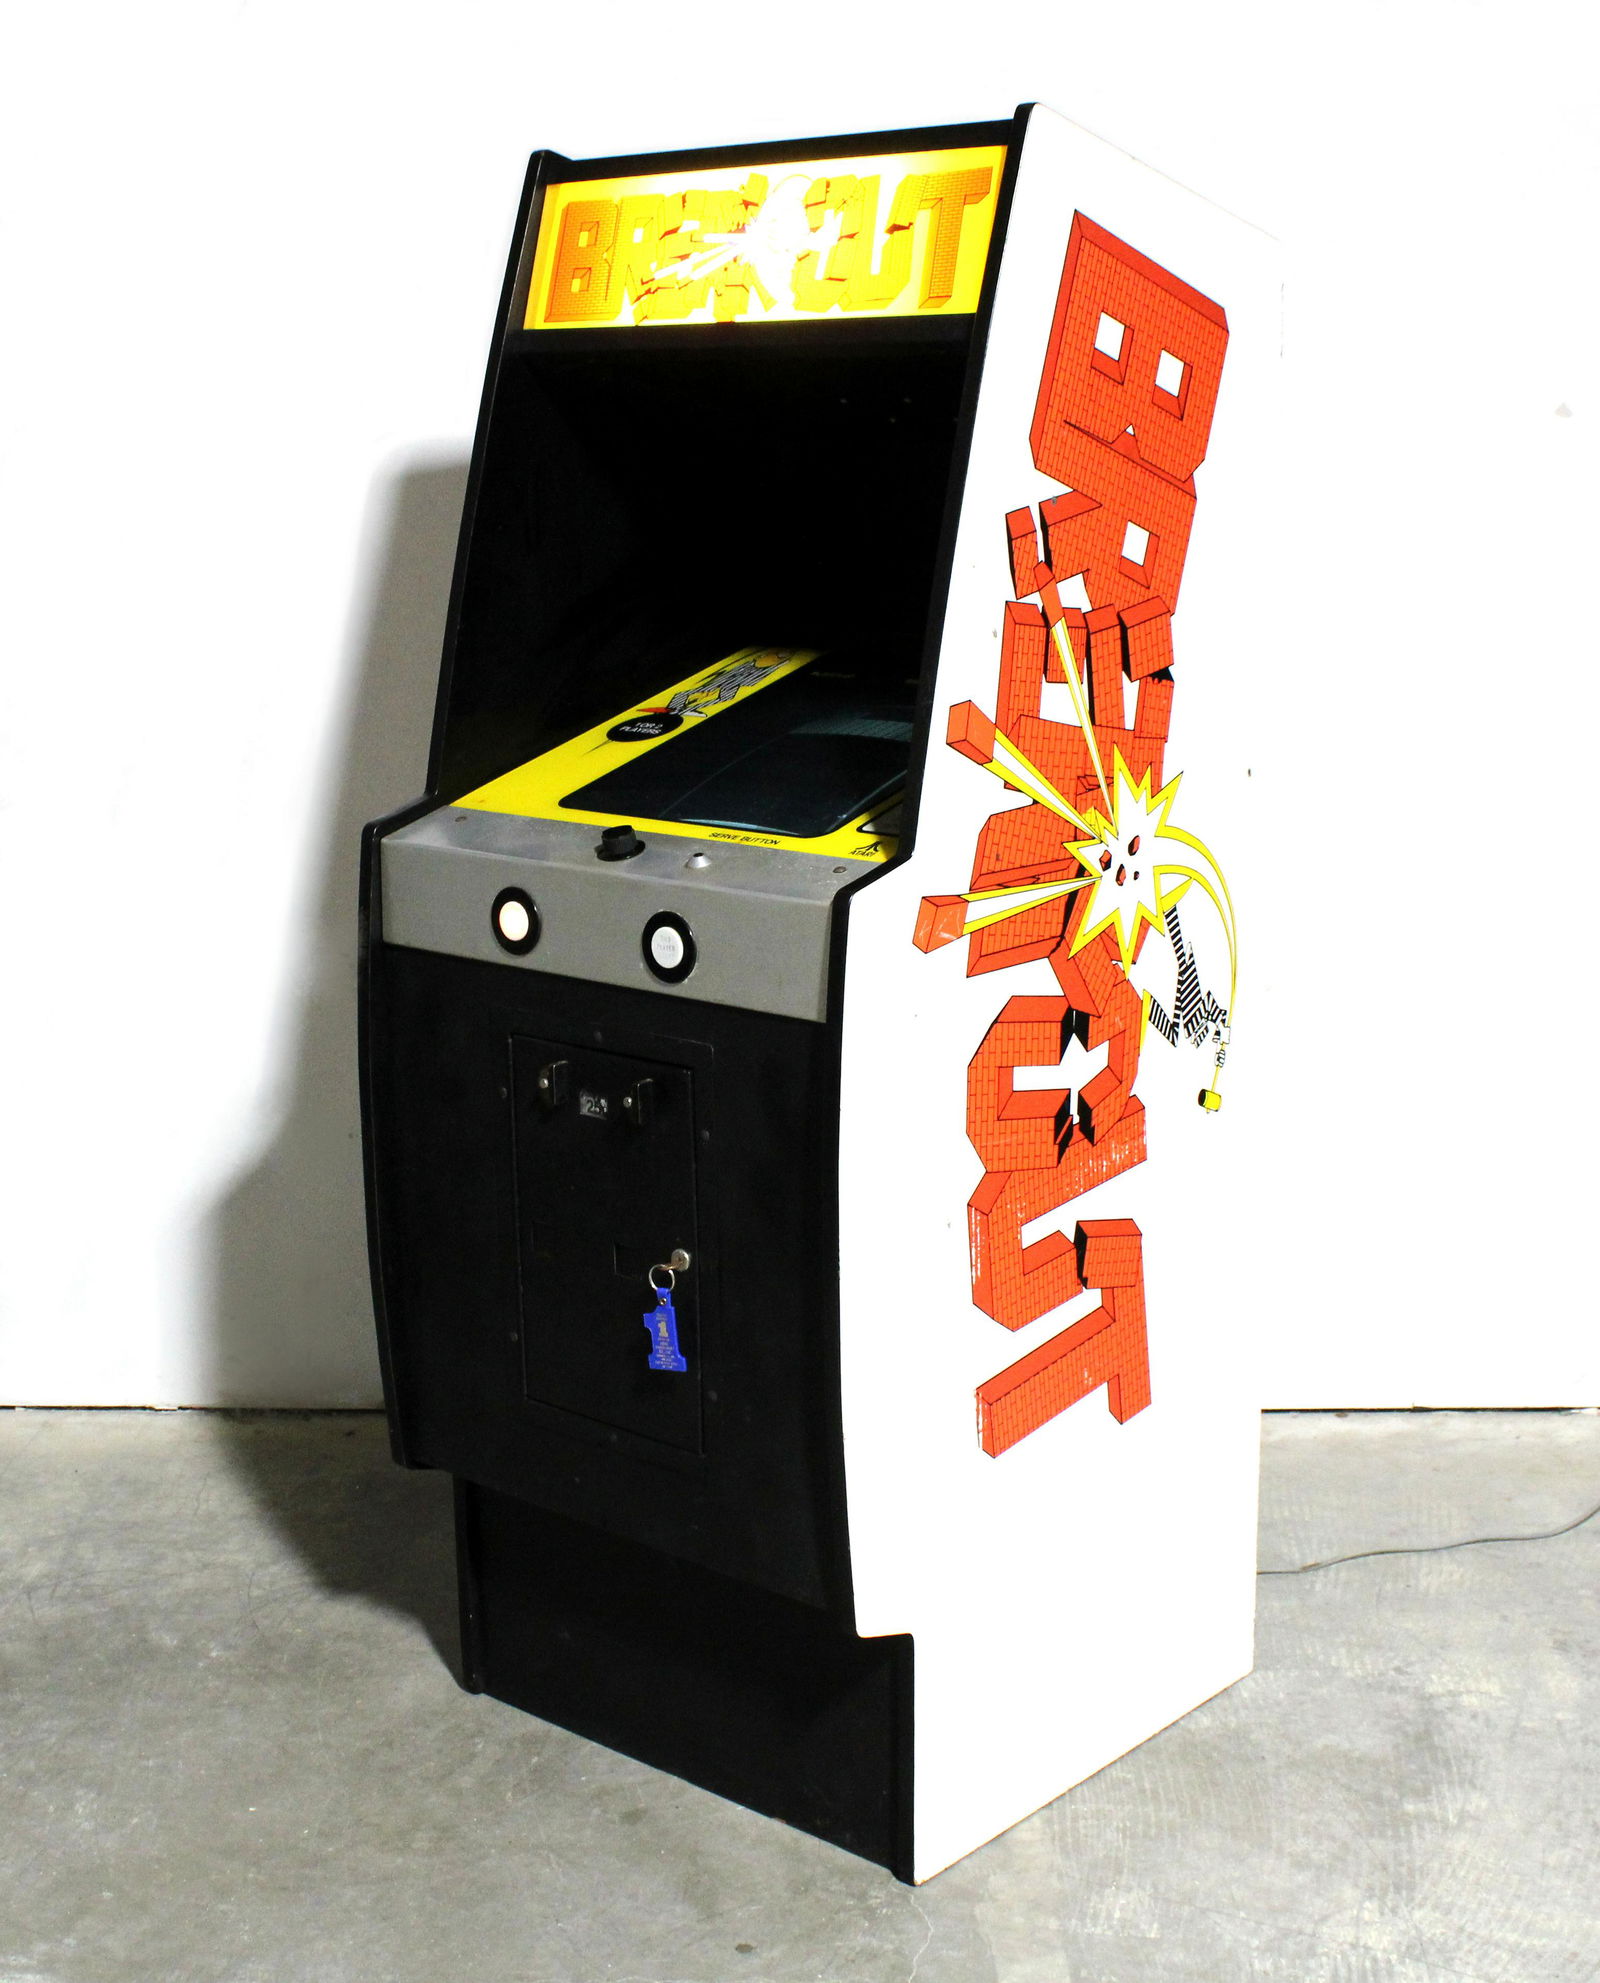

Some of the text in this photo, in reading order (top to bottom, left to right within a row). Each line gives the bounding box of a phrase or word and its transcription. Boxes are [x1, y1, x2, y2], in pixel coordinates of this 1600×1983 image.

[619, 726, 661, 735] PLAYERS
[708, 832, 781, 845] SERVE BUTTON
[848, 849, 876, 857] ATARI
